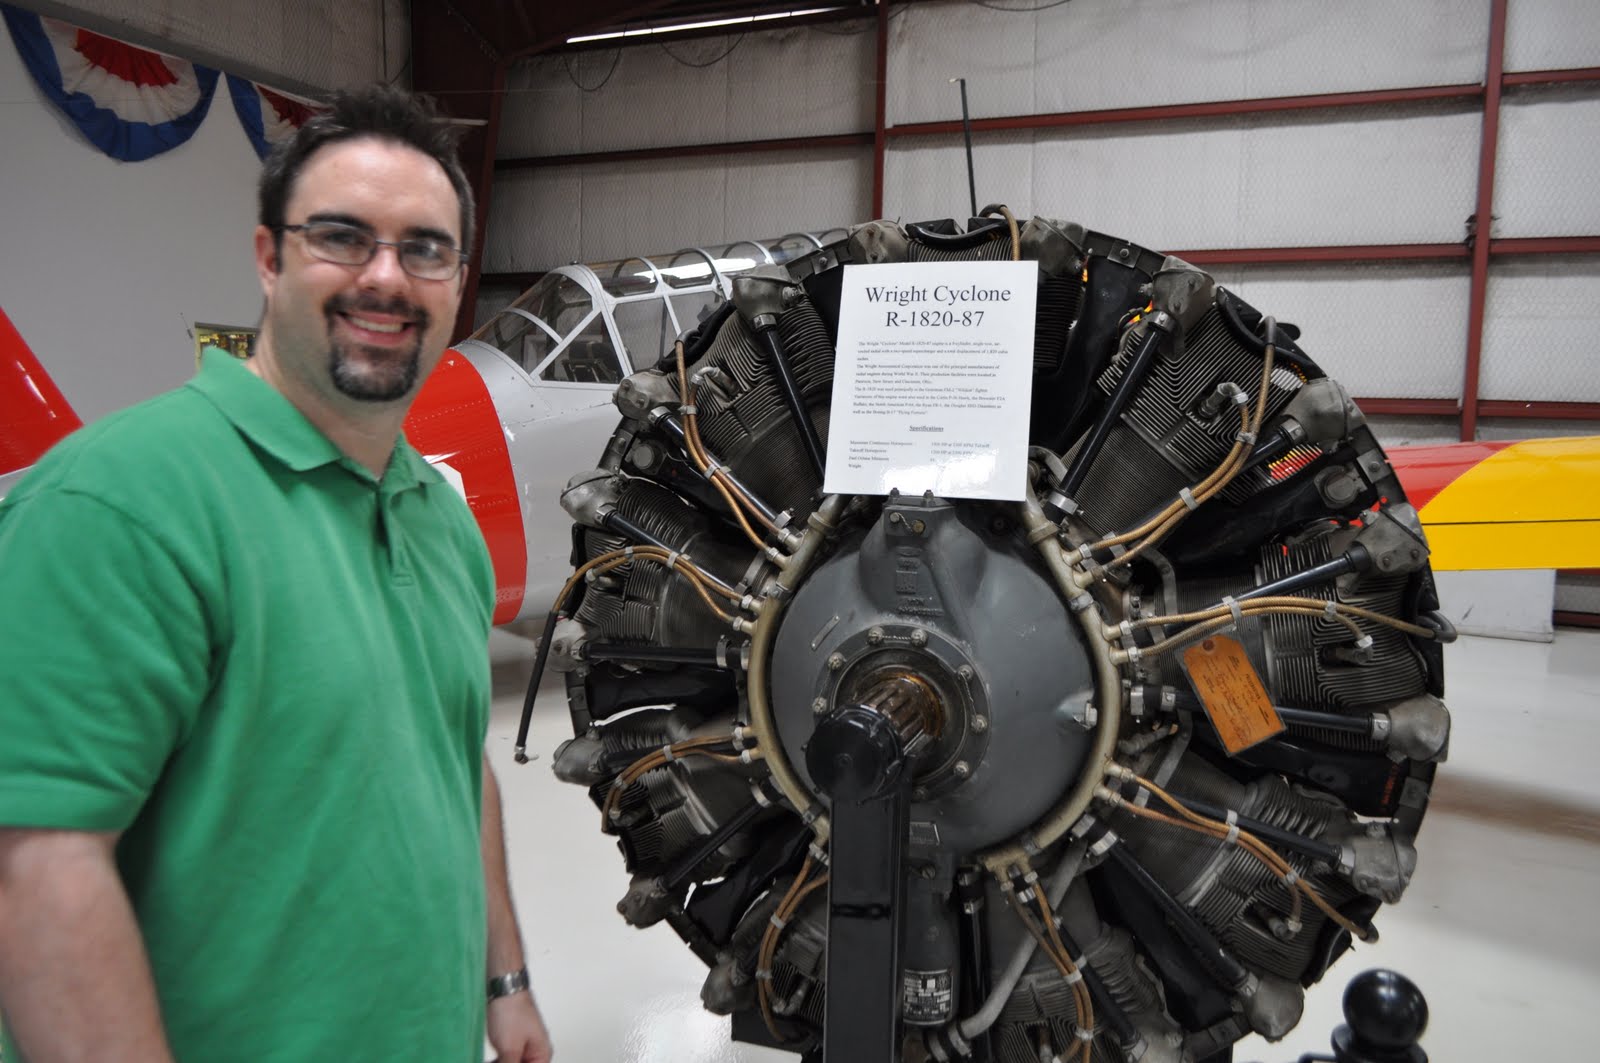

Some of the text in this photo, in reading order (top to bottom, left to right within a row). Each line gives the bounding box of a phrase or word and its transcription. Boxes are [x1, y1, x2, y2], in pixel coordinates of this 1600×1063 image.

[865, 284, 1012, 306] Wright Cyclone
[885, 310, 985, 328] R-1820-87
